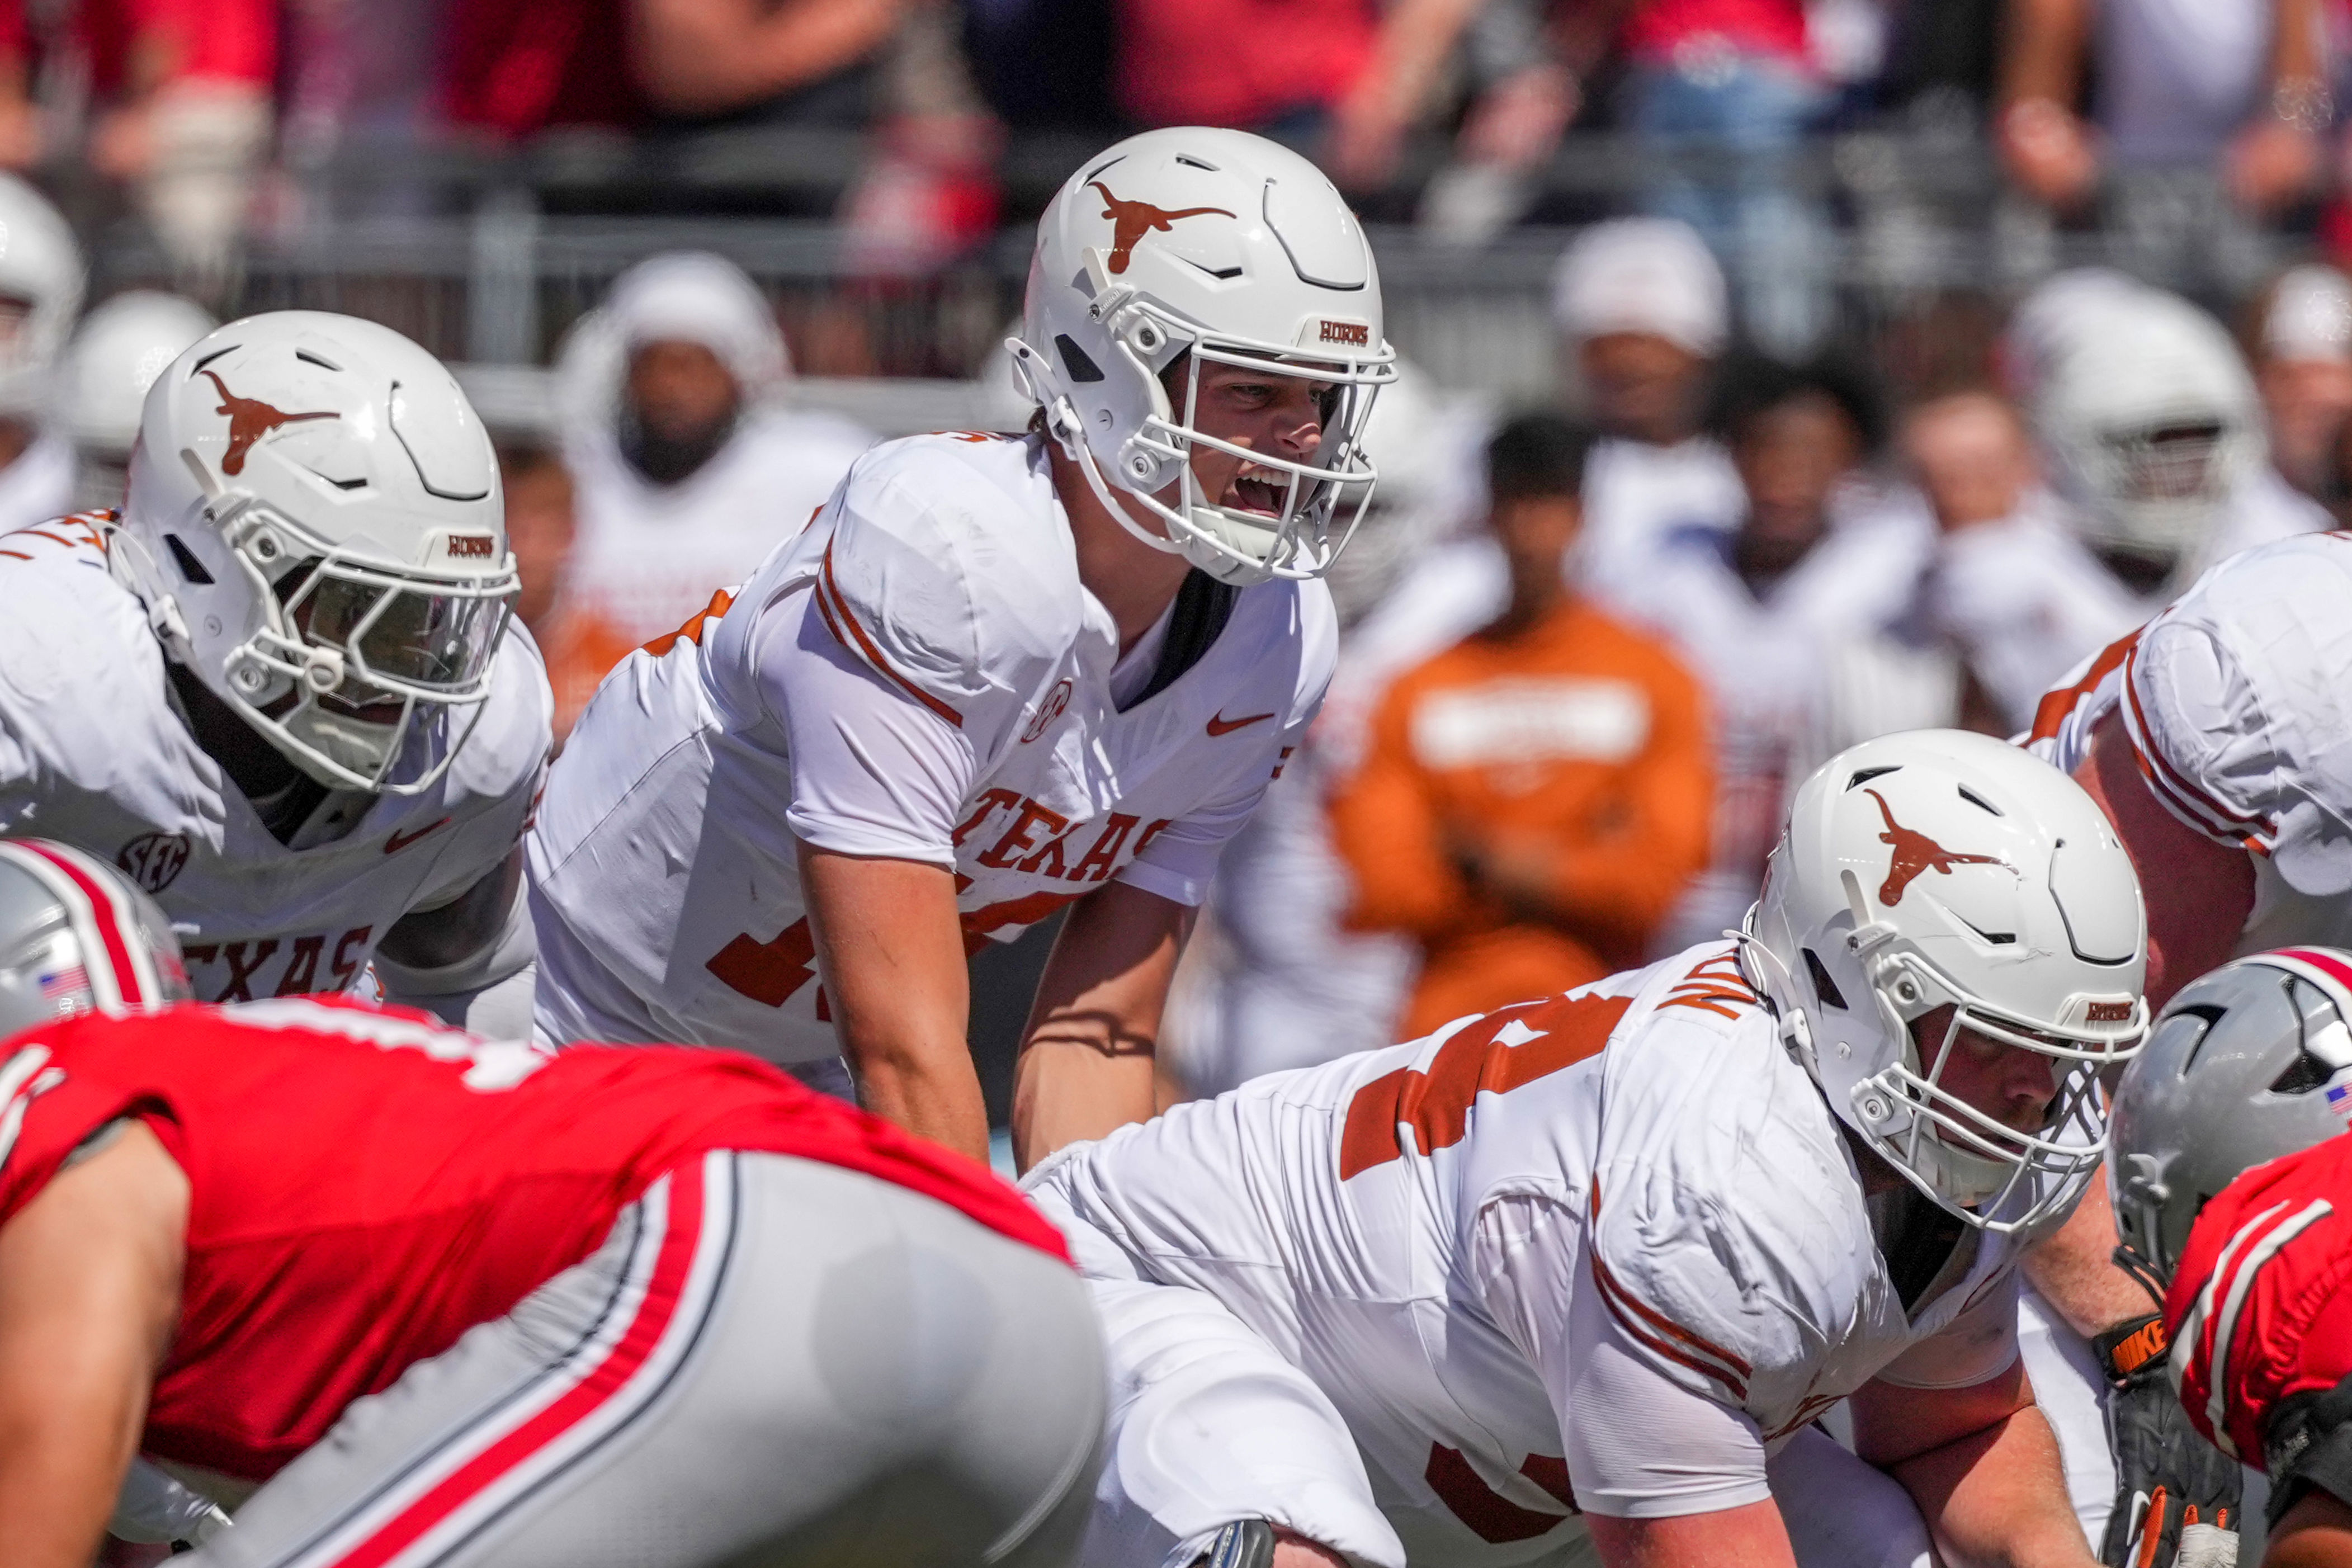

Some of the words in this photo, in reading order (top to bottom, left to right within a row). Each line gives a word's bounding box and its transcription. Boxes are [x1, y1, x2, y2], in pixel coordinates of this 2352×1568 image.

[1320, 320, 1368, 343] HORNS
[125, 836, 187, 889] SEC
[182, 924, 373, 1003] XAS
[2112, 1319, 2167, 1373] NIKE
